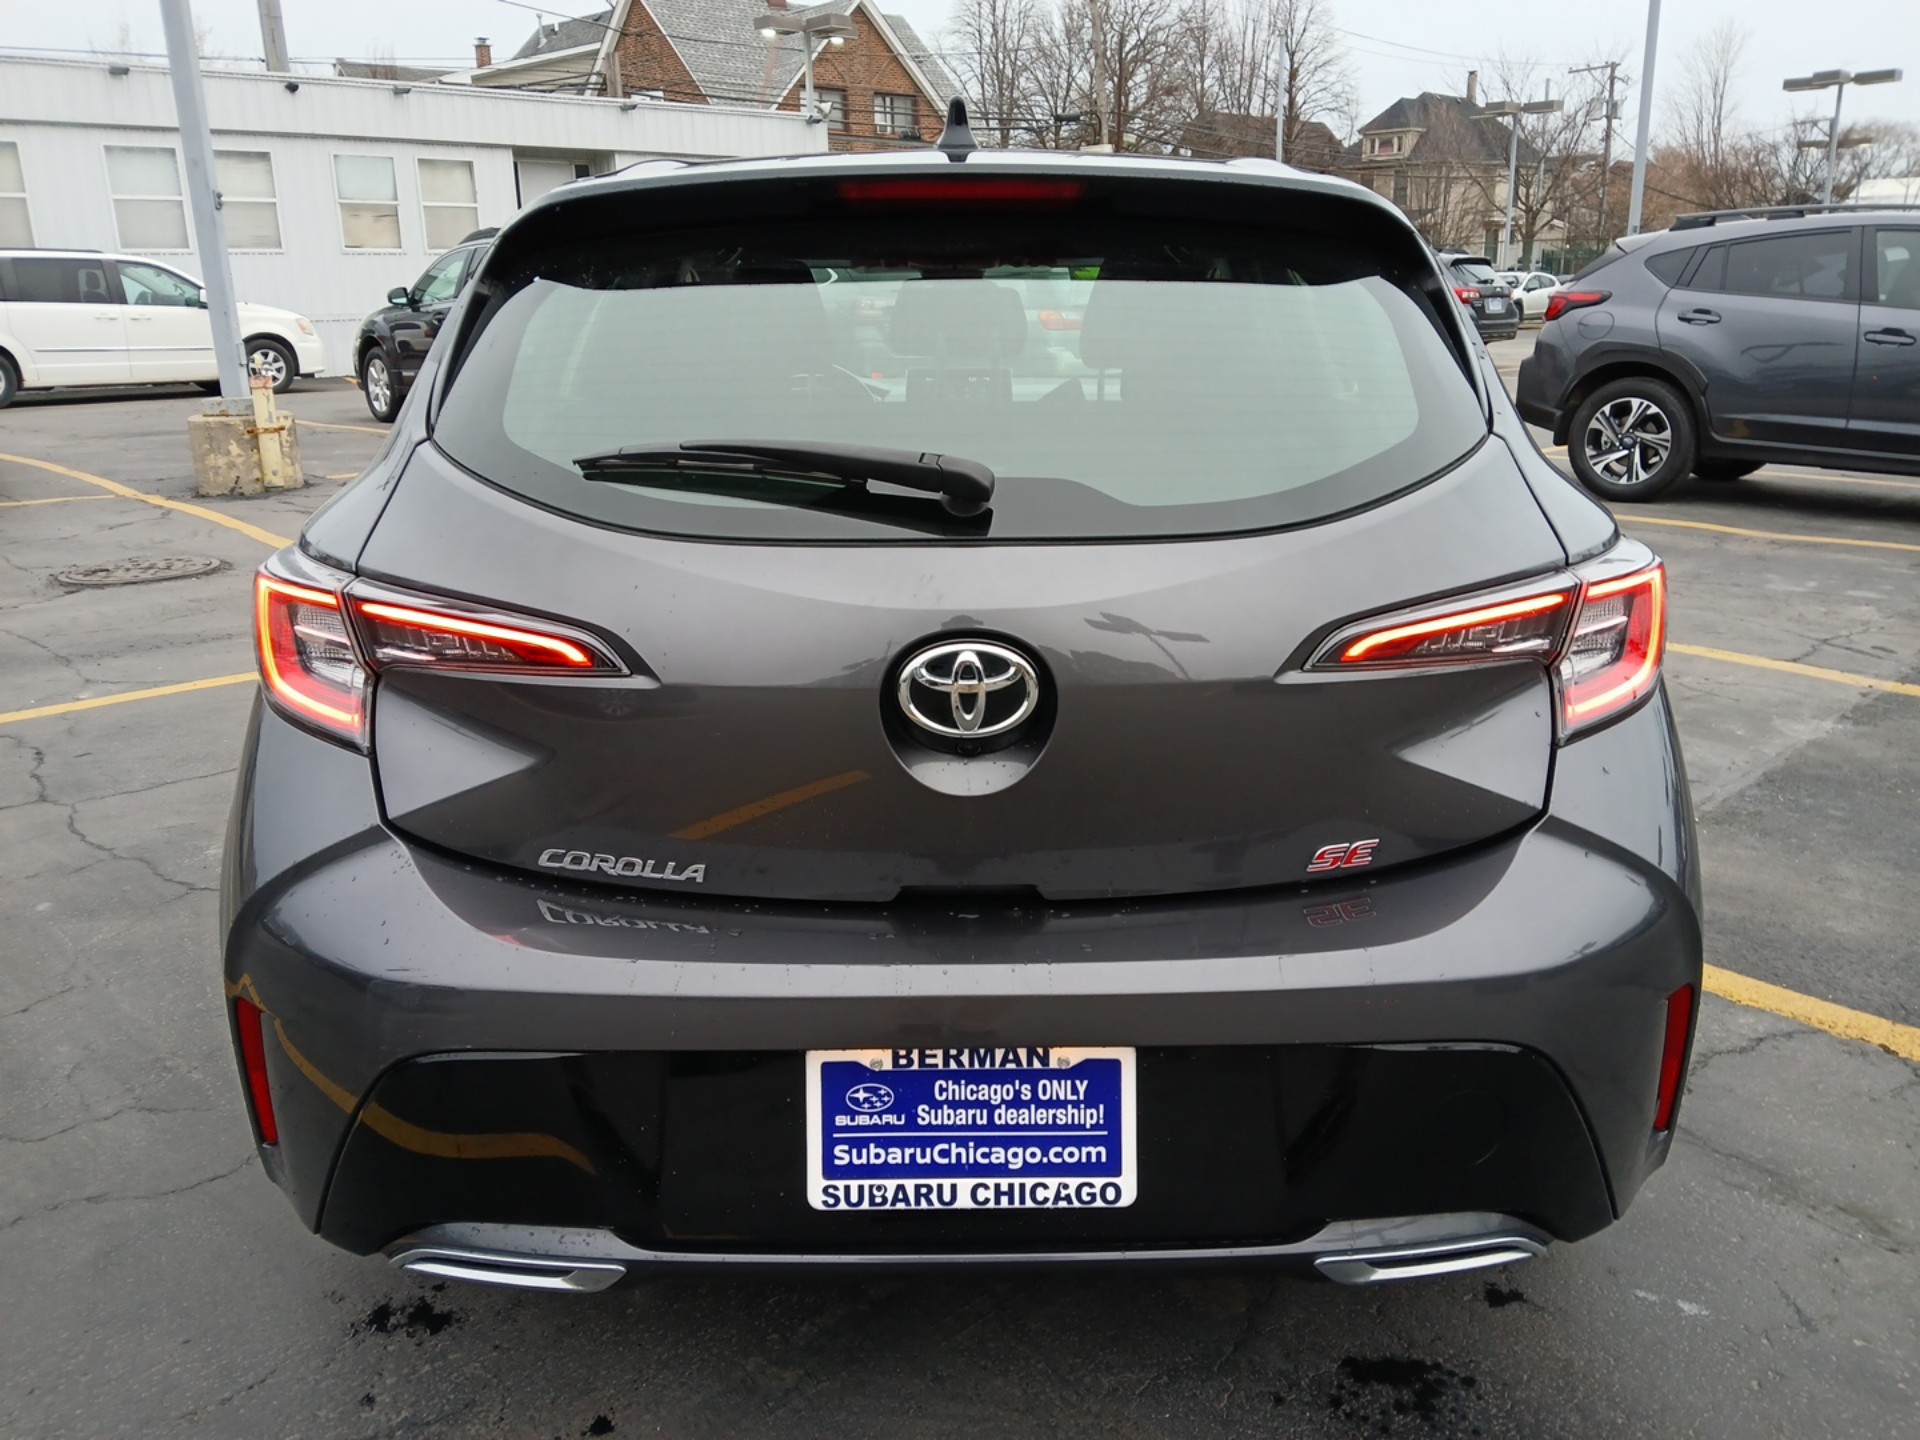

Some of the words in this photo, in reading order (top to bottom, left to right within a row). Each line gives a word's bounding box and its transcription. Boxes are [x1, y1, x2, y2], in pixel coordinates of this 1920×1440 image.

[538, 848, 706, 882] COROLLA
[1306, 838, 1380, 872] SE
[891, 1048, 1050, 1069] BERMAN
[934, 1079, 1032, 1102] Chicago's
[1037, 1079, 1089, 1101] ONLY
[834, 1113, 905, 1126] SUBARU
[916, 1105, 989, 1126] Subaru
[994, 1103, 1105, 1128] dealership!
[833, 1142, 1107, 1169] SubaruChicago.com
[821, 1184, 958, 1209] SUBARU
[969, 1182, 1123, 1207] CHICAGO
